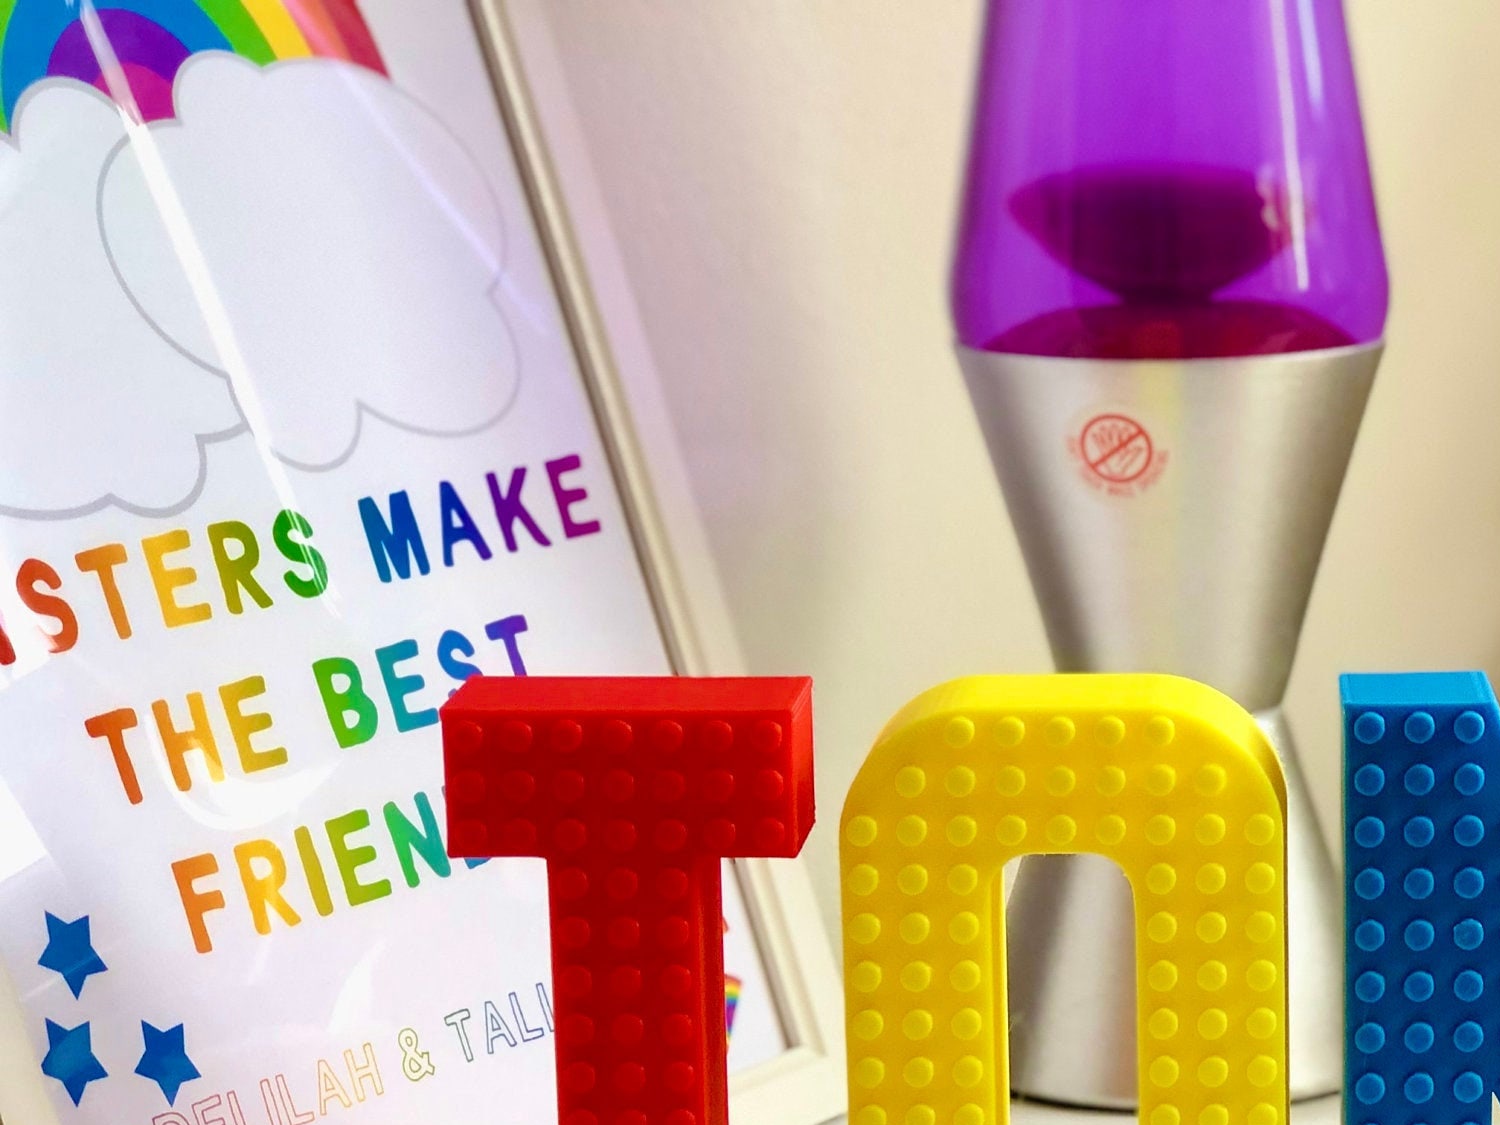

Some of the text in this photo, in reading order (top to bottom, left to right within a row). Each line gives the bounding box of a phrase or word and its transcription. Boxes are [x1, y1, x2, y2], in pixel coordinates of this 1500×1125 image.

[0, 454, 602, 666] STERS MAKE
[84, 614, 528, 805] THE BEST
[171, 786, 492, 954] FRIEN
[397, 1027, 436, 1082] &
